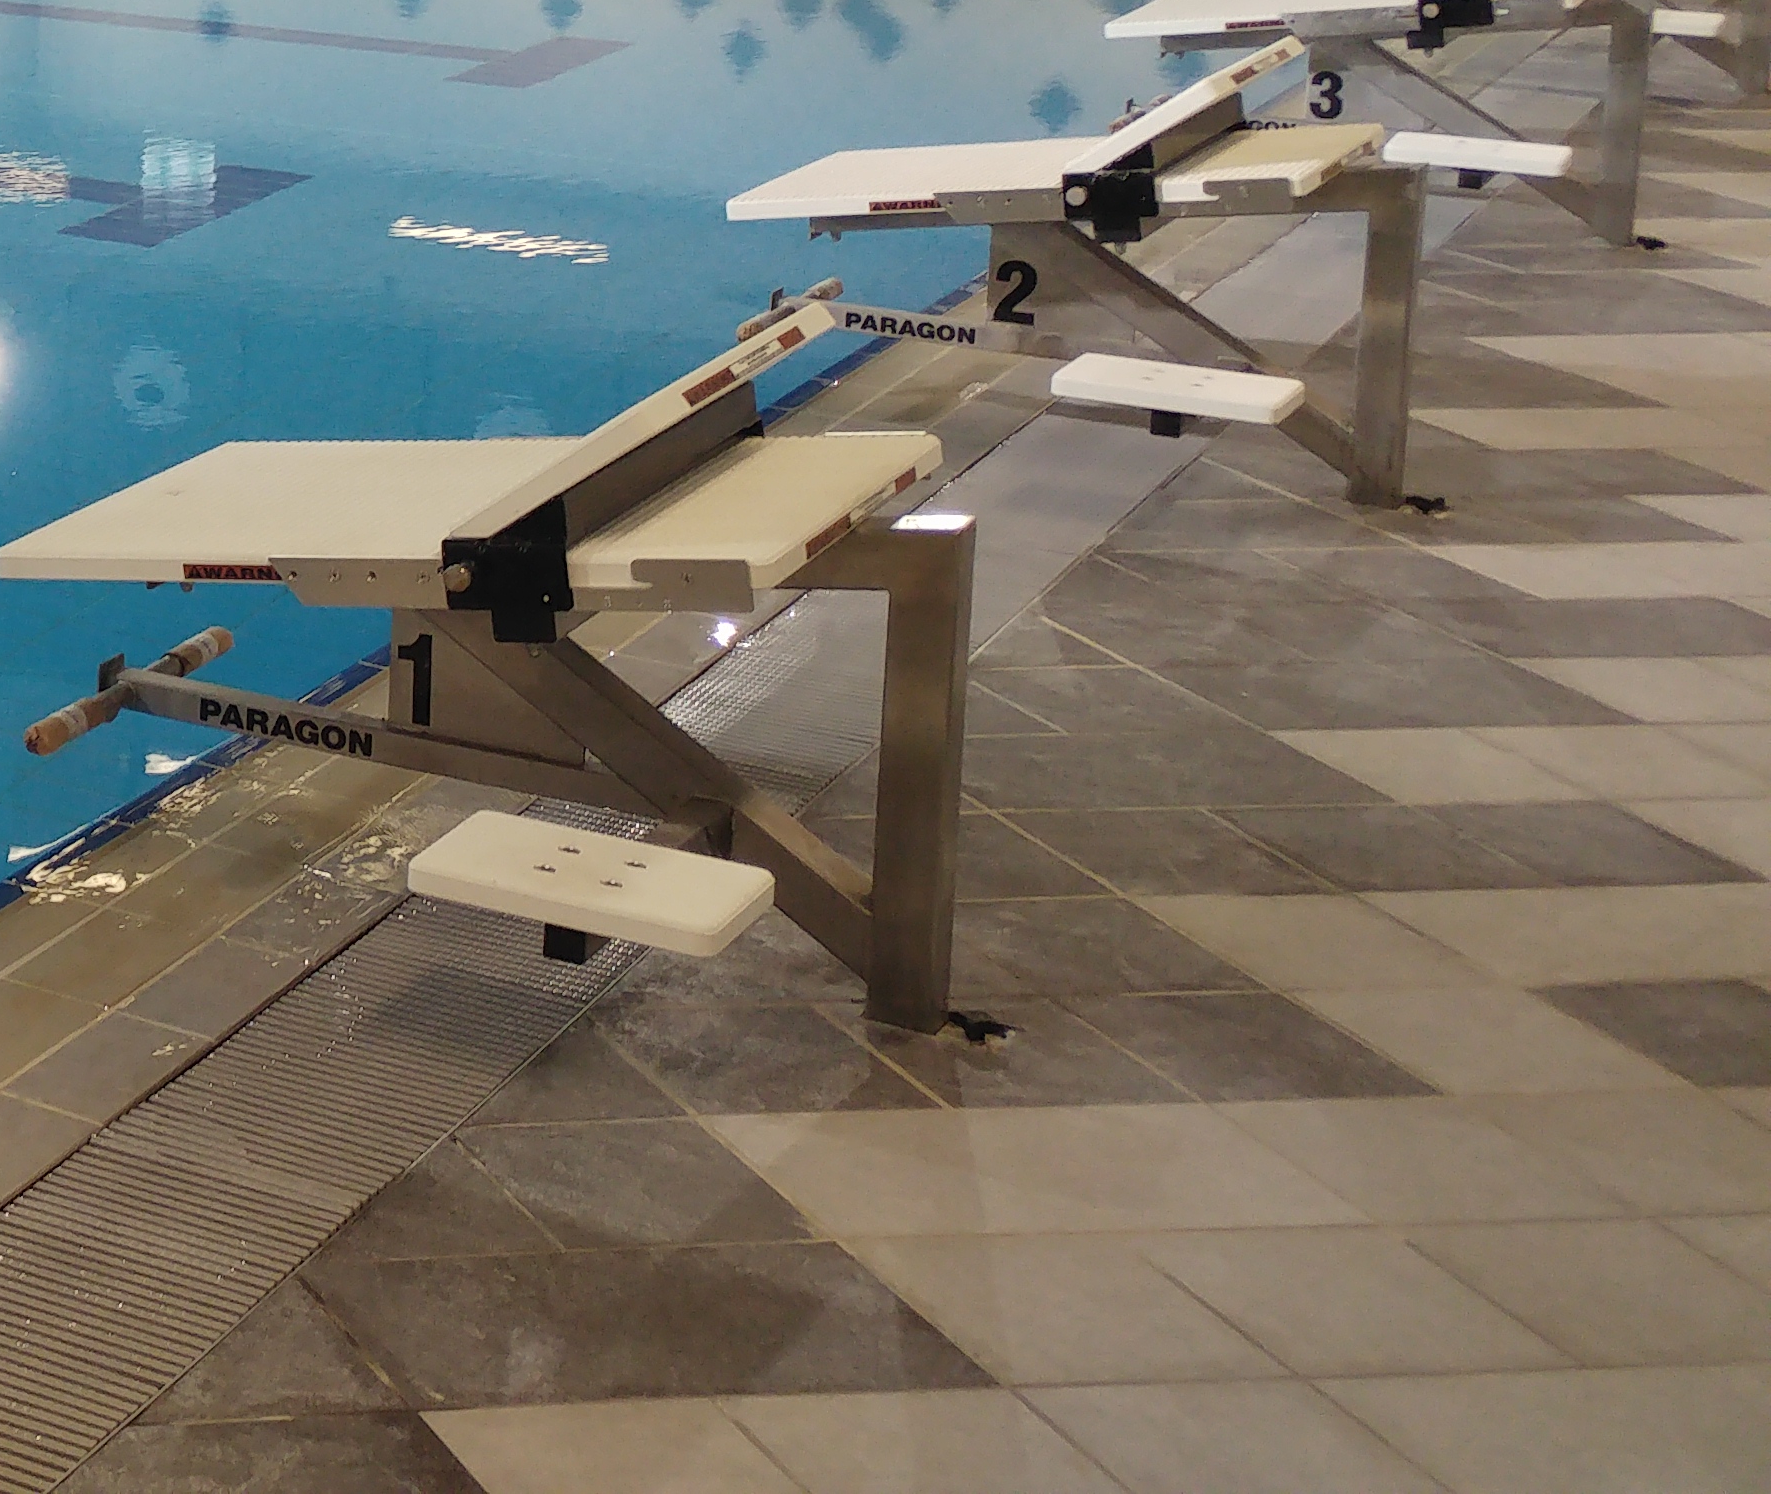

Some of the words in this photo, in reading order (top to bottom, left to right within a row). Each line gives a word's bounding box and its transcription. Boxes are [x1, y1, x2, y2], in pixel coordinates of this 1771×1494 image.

[1309, 70, 1343, 120] 3
[993, 259, 1038, 326] 2
[845, 310, 977, 345] PARAGON
[397, 633, 433, 727] 1
[199, 698, 373, 758] PARAGON
